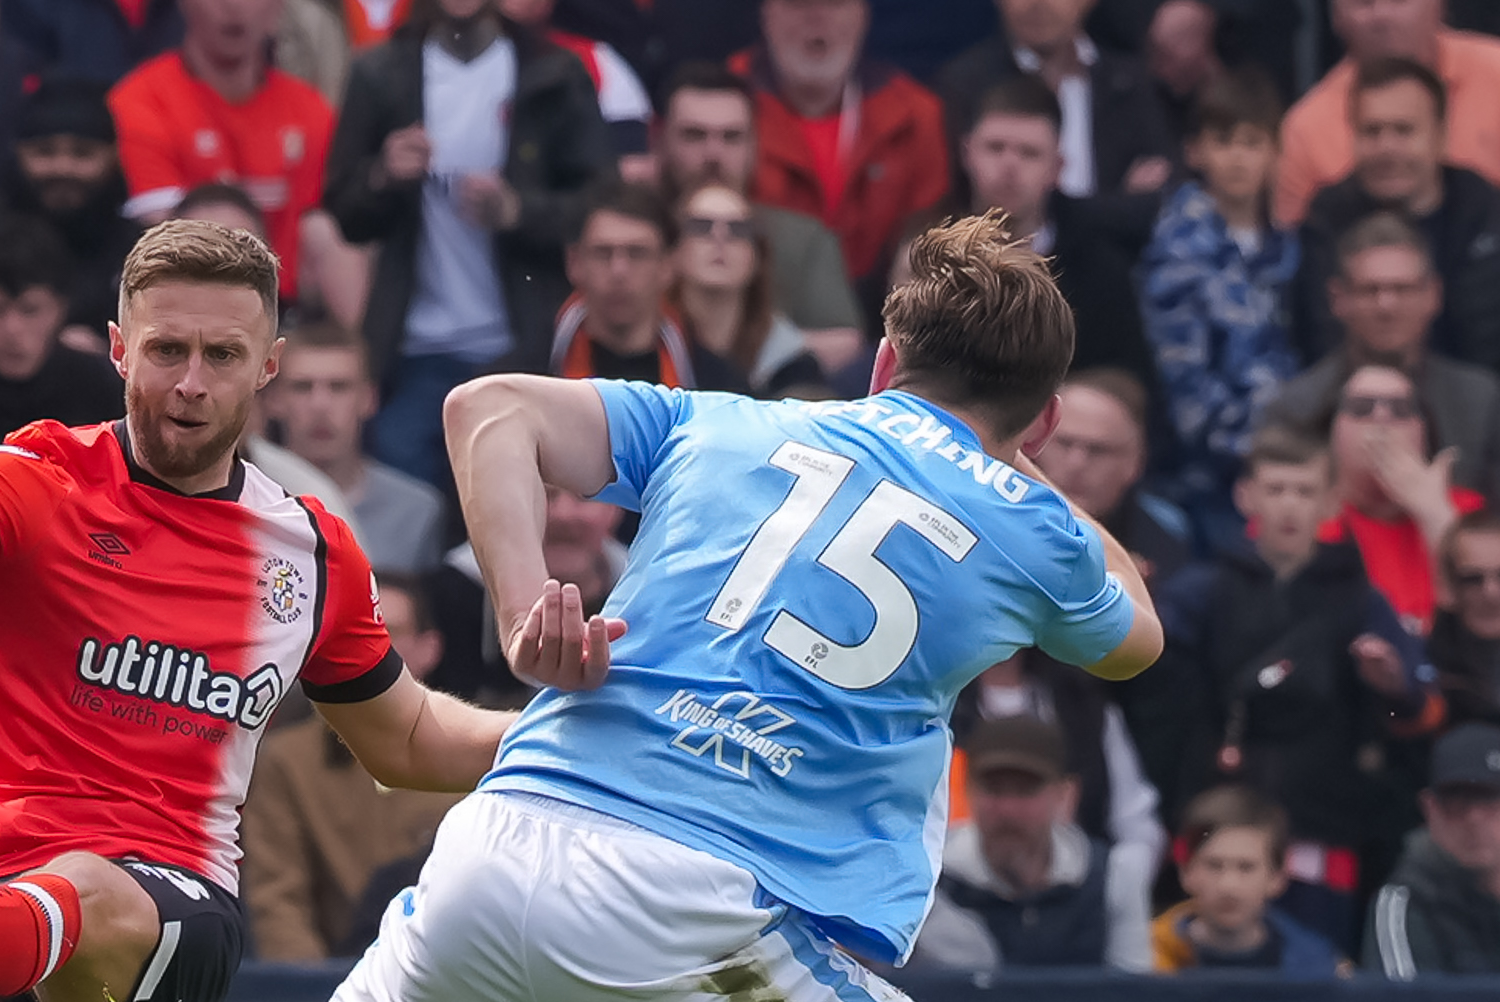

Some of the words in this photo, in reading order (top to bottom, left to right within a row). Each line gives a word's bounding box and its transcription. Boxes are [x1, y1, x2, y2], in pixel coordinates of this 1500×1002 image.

[88, 550, 123, 570] umbro
[704, 439, 981, 691] 15
[79, 637, 241, 719] utilita
[71, 685, 104, 713] life
[111, 700, 158, 727] with
[162, 716, 229, 745] power
